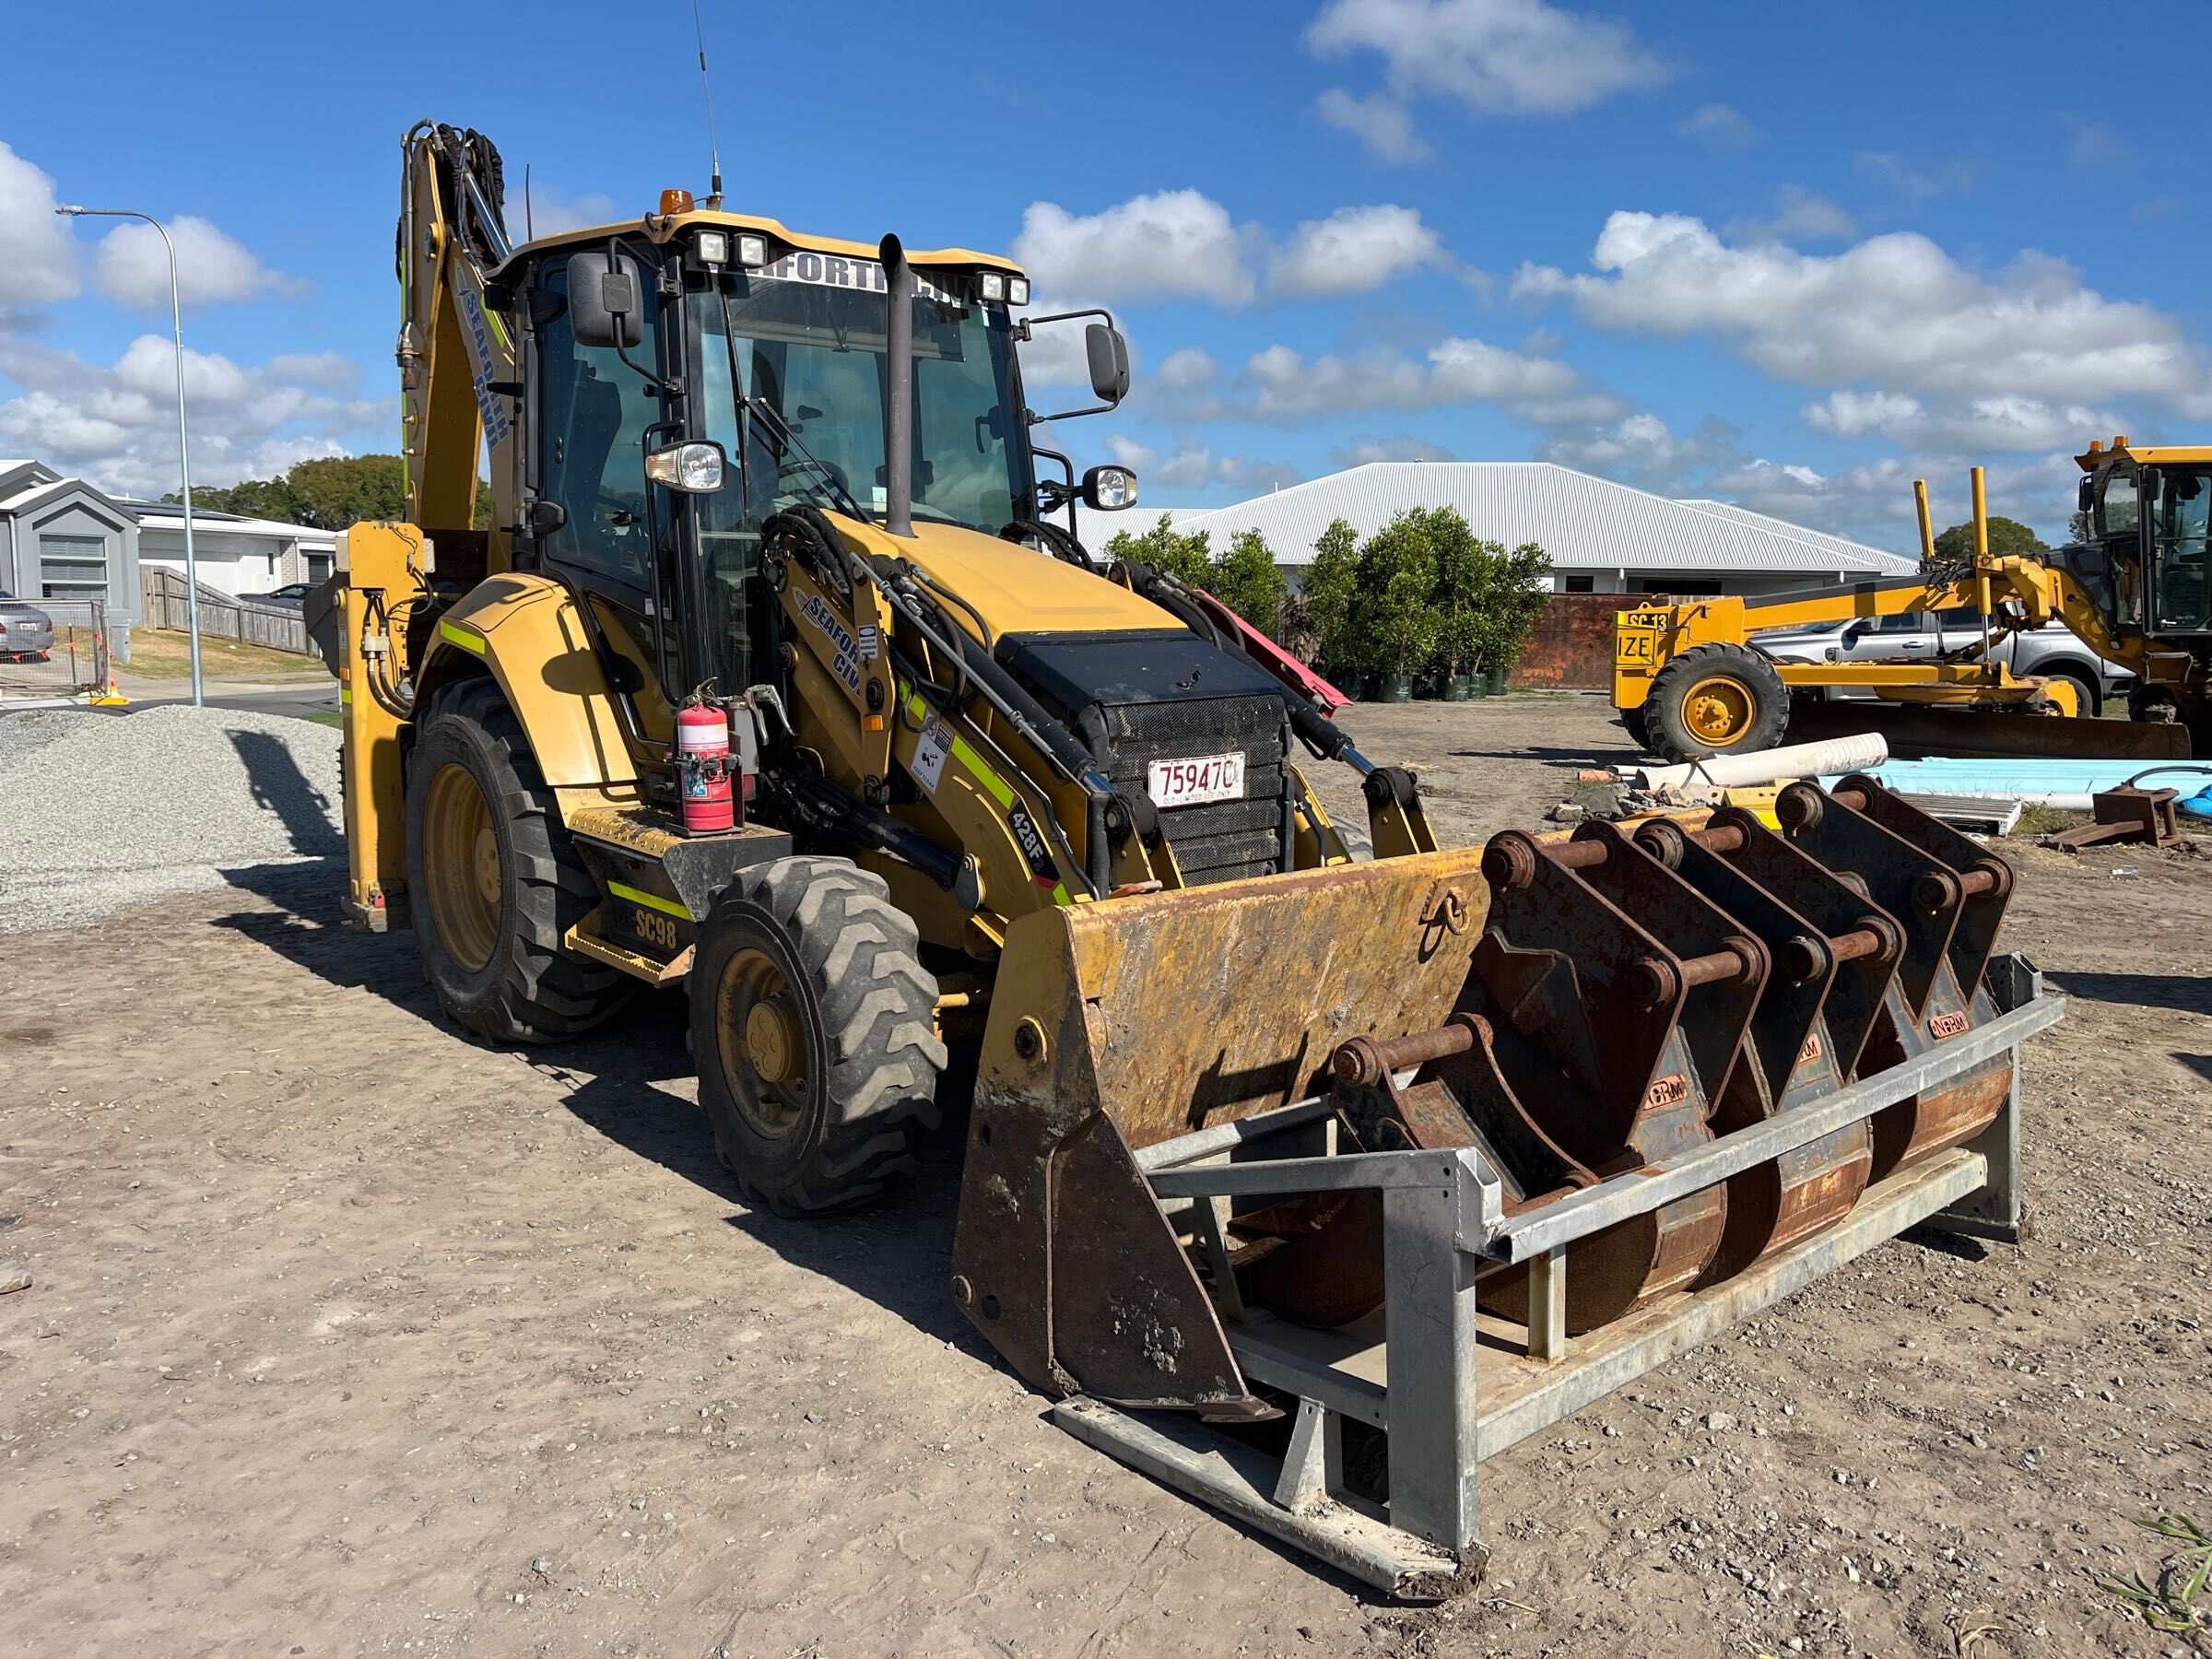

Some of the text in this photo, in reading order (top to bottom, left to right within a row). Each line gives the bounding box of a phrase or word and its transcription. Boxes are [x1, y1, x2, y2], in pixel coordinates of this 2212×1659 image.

[475, 375, 499, 449] CIVIL
[1651, 614, 1667, 632] 13
[833, 652, 861, 698] CIV
[636, 909, 677, 950] SC98
